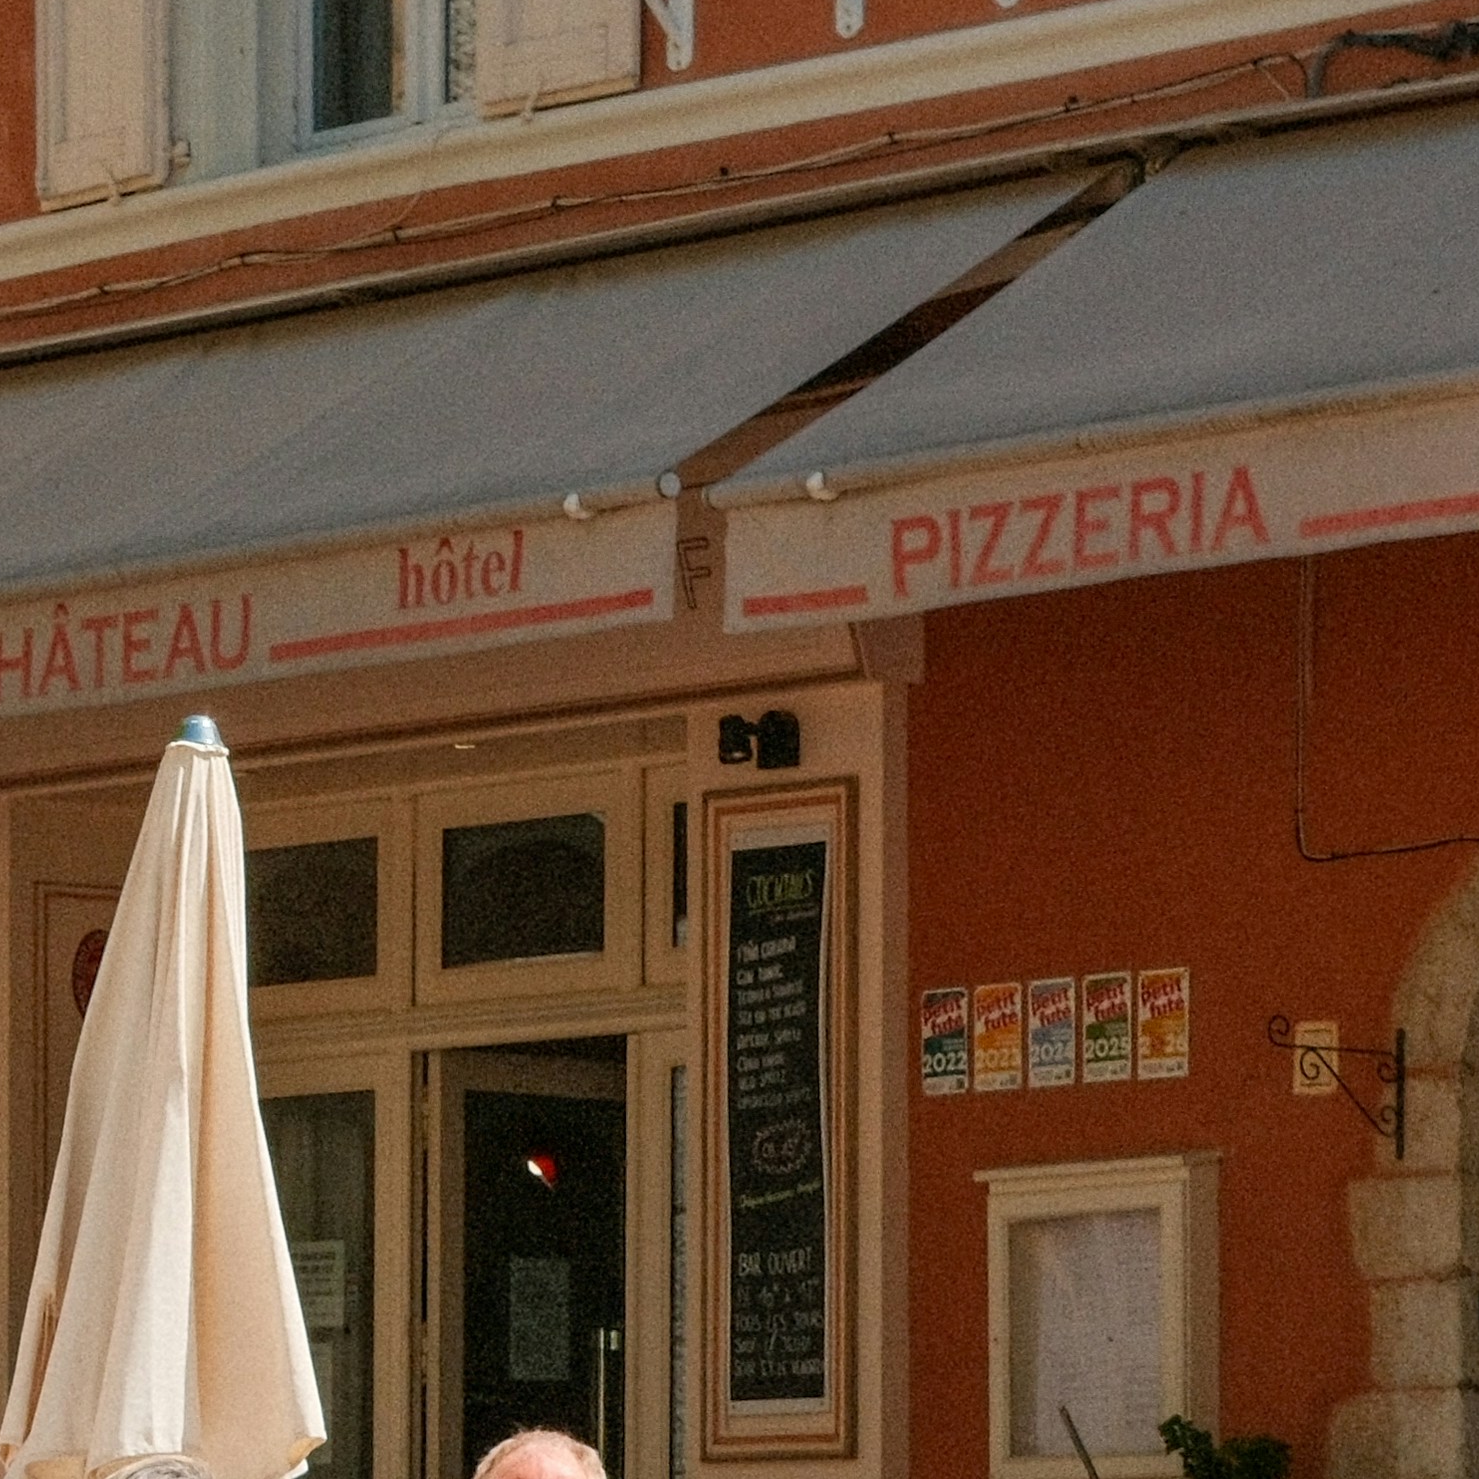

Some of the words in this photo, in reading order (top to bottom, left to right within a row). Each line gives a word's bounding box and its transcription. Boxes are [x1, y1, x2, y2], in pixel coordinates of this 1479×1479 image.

[890, 464, 1270, 599] PIZZERIA
[396, 528, 525, 610] hôtel
[923, 1050, 967, 1074] 2022
[1085, 1036, 1129, 1059] 2025
